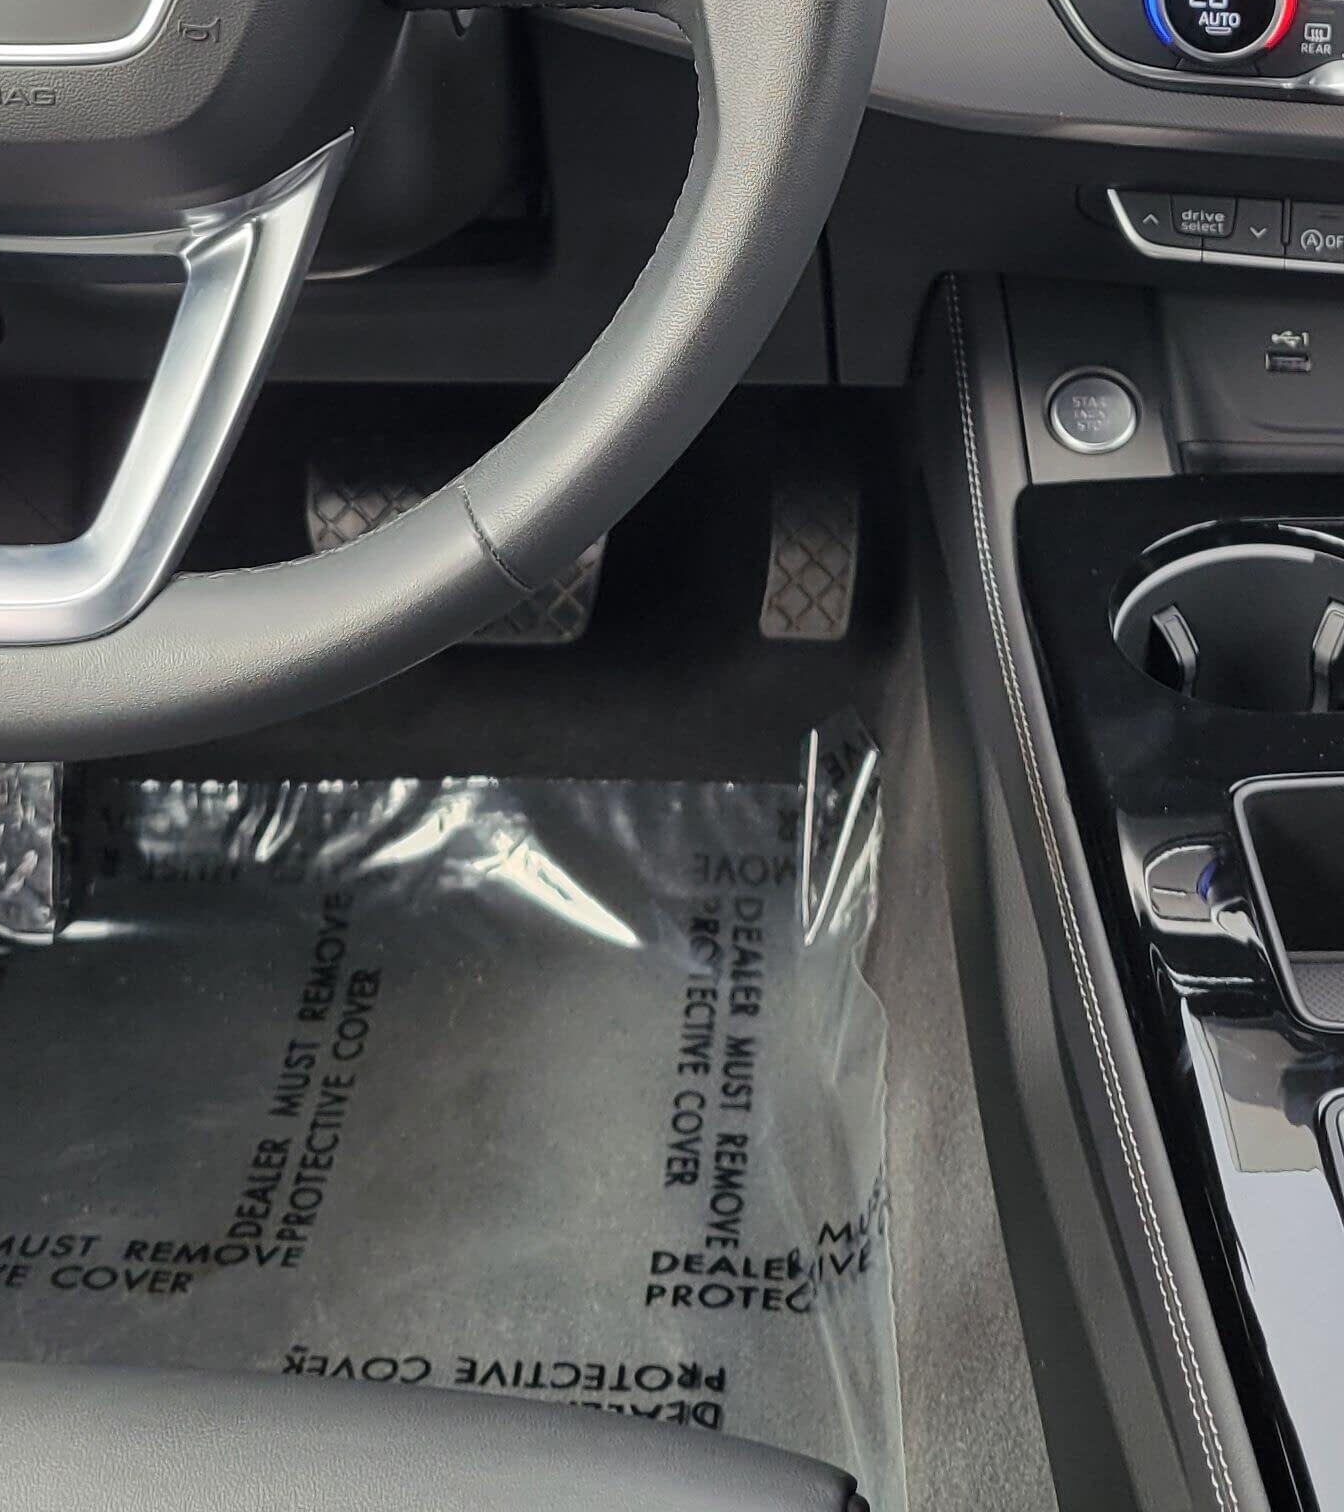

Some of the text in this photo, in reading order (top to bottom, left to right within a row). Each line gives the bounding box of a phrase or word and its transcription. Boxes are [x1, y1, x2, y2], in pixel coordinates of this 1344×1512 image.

[1198, 11, 1241, 28] AUTO
[1300, 42, 1332, 55] REAR
[1180, 220, 1225, 234] select
[1181, 209, 1226, 222] drive
[228, 890, 355, 1240] DEALER MUST REMOVE
[705, 897, 764, 1249] DEALER MUST REMOVE
[276, 967, 383, 1243] PROTECTIVE COVER
[665, 1089, 706, 1191] COVER
[123, 1238, 304, 1269] REMOVE
[50, 1264, 195, 1295] COVER
[280, 1345, 727, 1394] PROTECTIVE COVER
